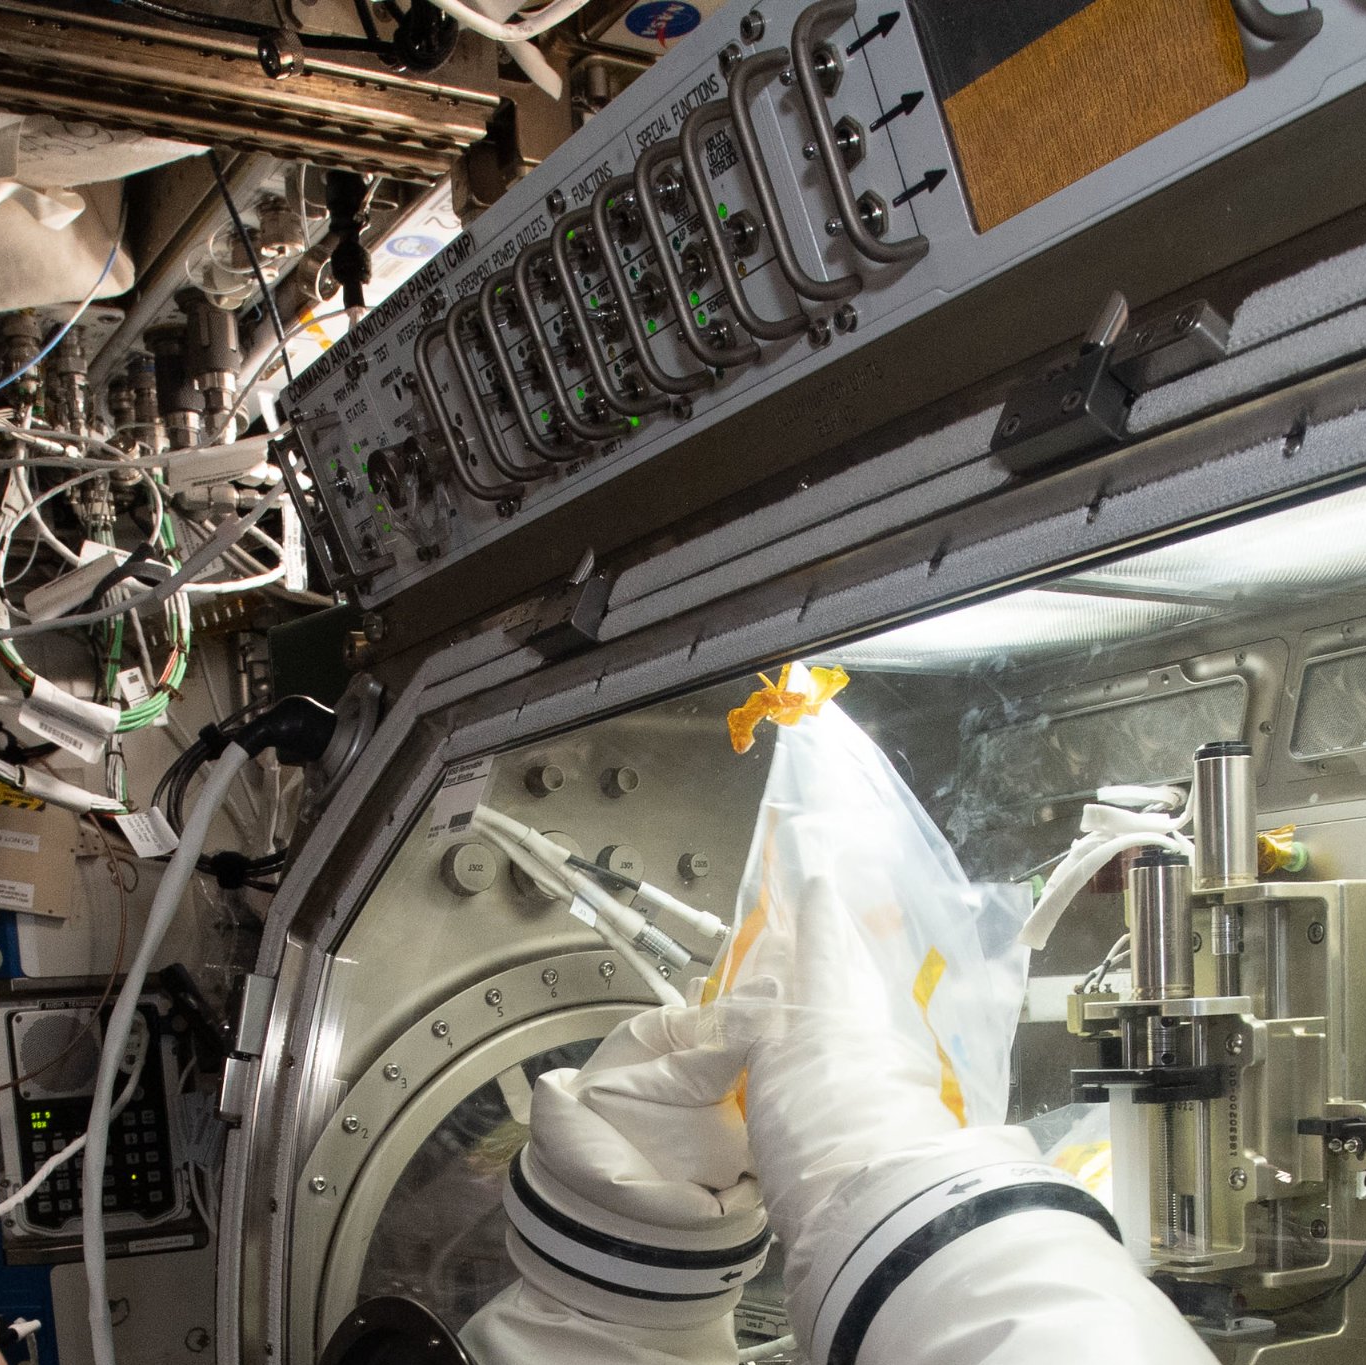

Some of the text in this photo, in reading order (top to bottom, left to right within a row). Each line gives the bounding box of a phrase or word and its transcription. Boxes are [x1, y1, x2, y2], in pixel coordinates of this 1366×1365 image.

[636, 74, 721, 151] SPECIAL FUNCTIONS
[571, 161, 614, 205] FUNCTIONS
[491, 240, 517, 270] POWER
[516, 215, 548, 249] OUTLETS
[287, 358, 330, 402] COMMAND
[330, 344, 351, 369] AND
[350, 290, 409, 351] MONITORING
[409, 264, 446, 303] PANEL
[444, 231, 477, 273] (CMP)
[373, 343, 389, 365] TEST
[345, 398, 368, 424] STATUS
[468, 864, 484, 872] J302
[605, 978, 612, 990] 7
[550, 986, 557, 998] 6
[497, 1005, 504, 1017] 5
[446, 1037, 453, 1048] 4
[400, 1077, 407, 1089] 3
[361, 1128, 369, 1139] 2
